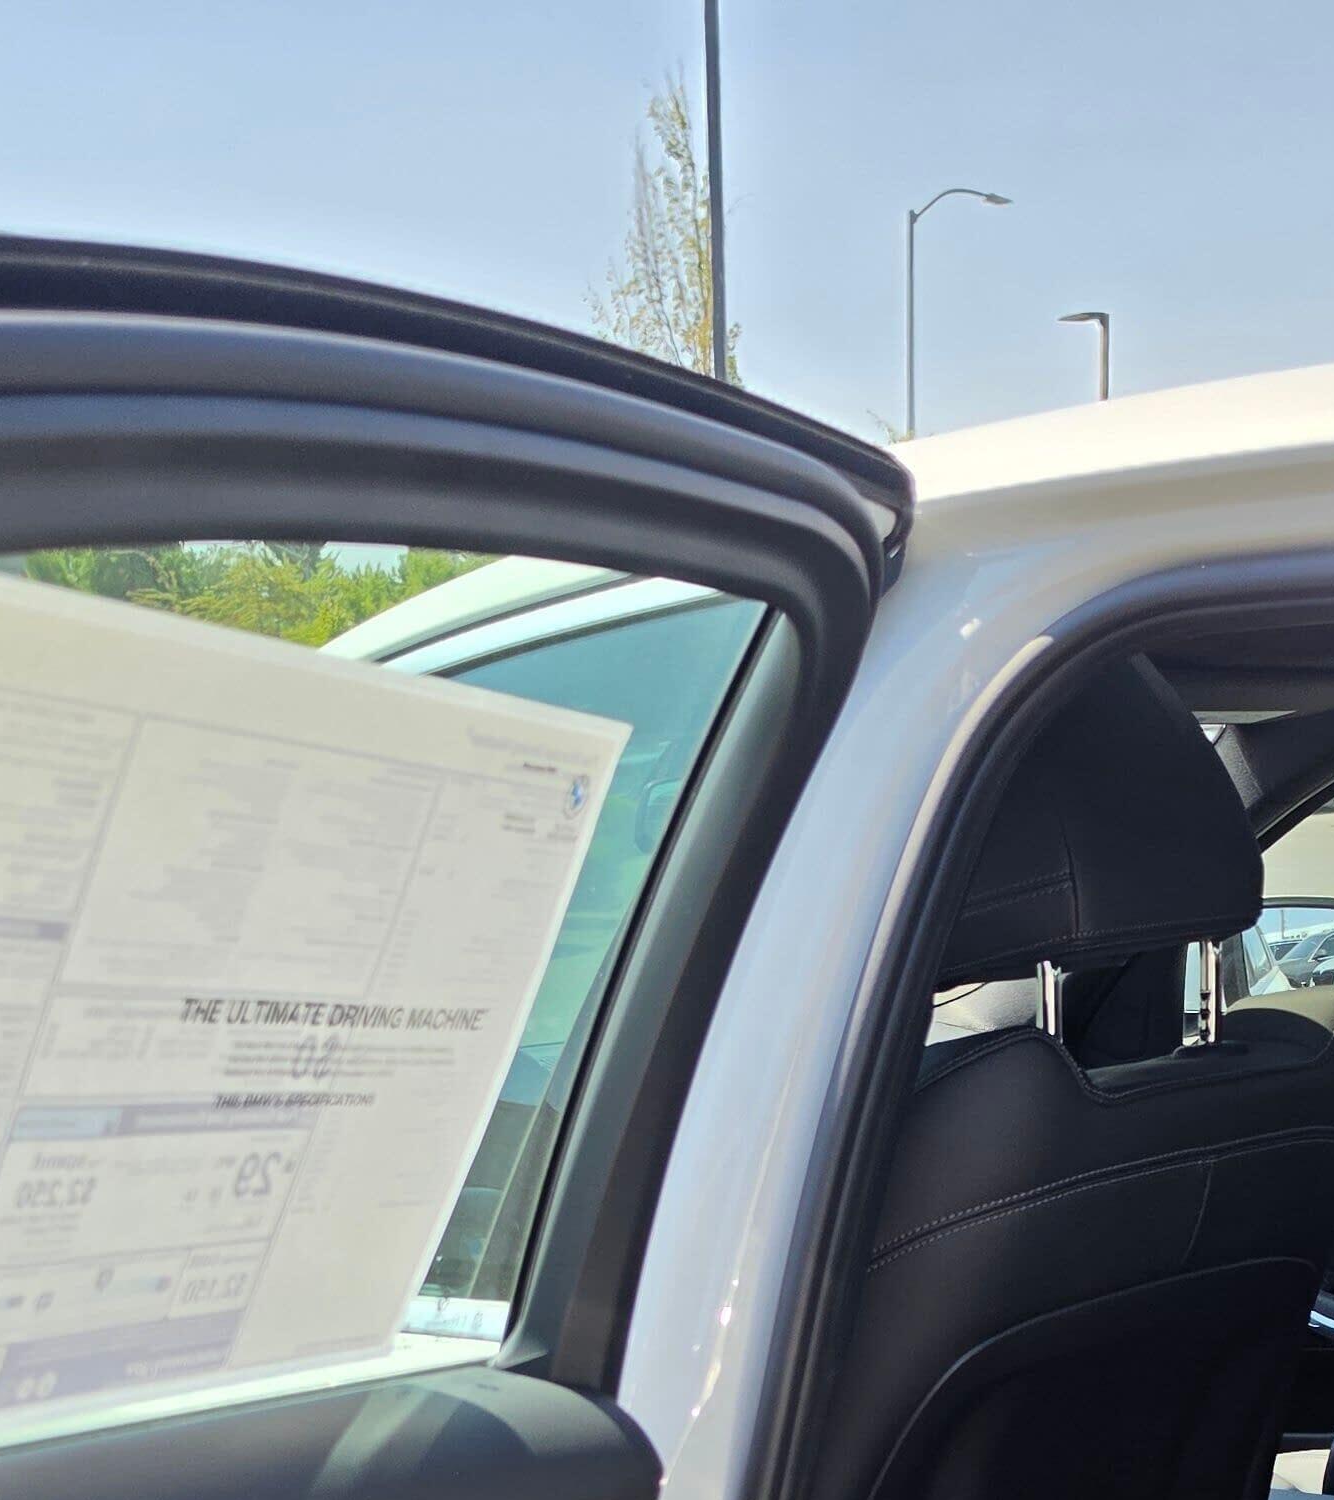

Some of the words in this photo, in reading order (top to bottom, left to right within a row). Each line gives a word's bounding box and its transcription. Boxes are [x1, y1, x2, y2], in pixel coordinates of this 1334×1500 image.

[179, 997, 221, 1025] THE
[225, 999, 327, 1028] ULTIMATE
[327, 1003, 405, 1030] DRIVING
